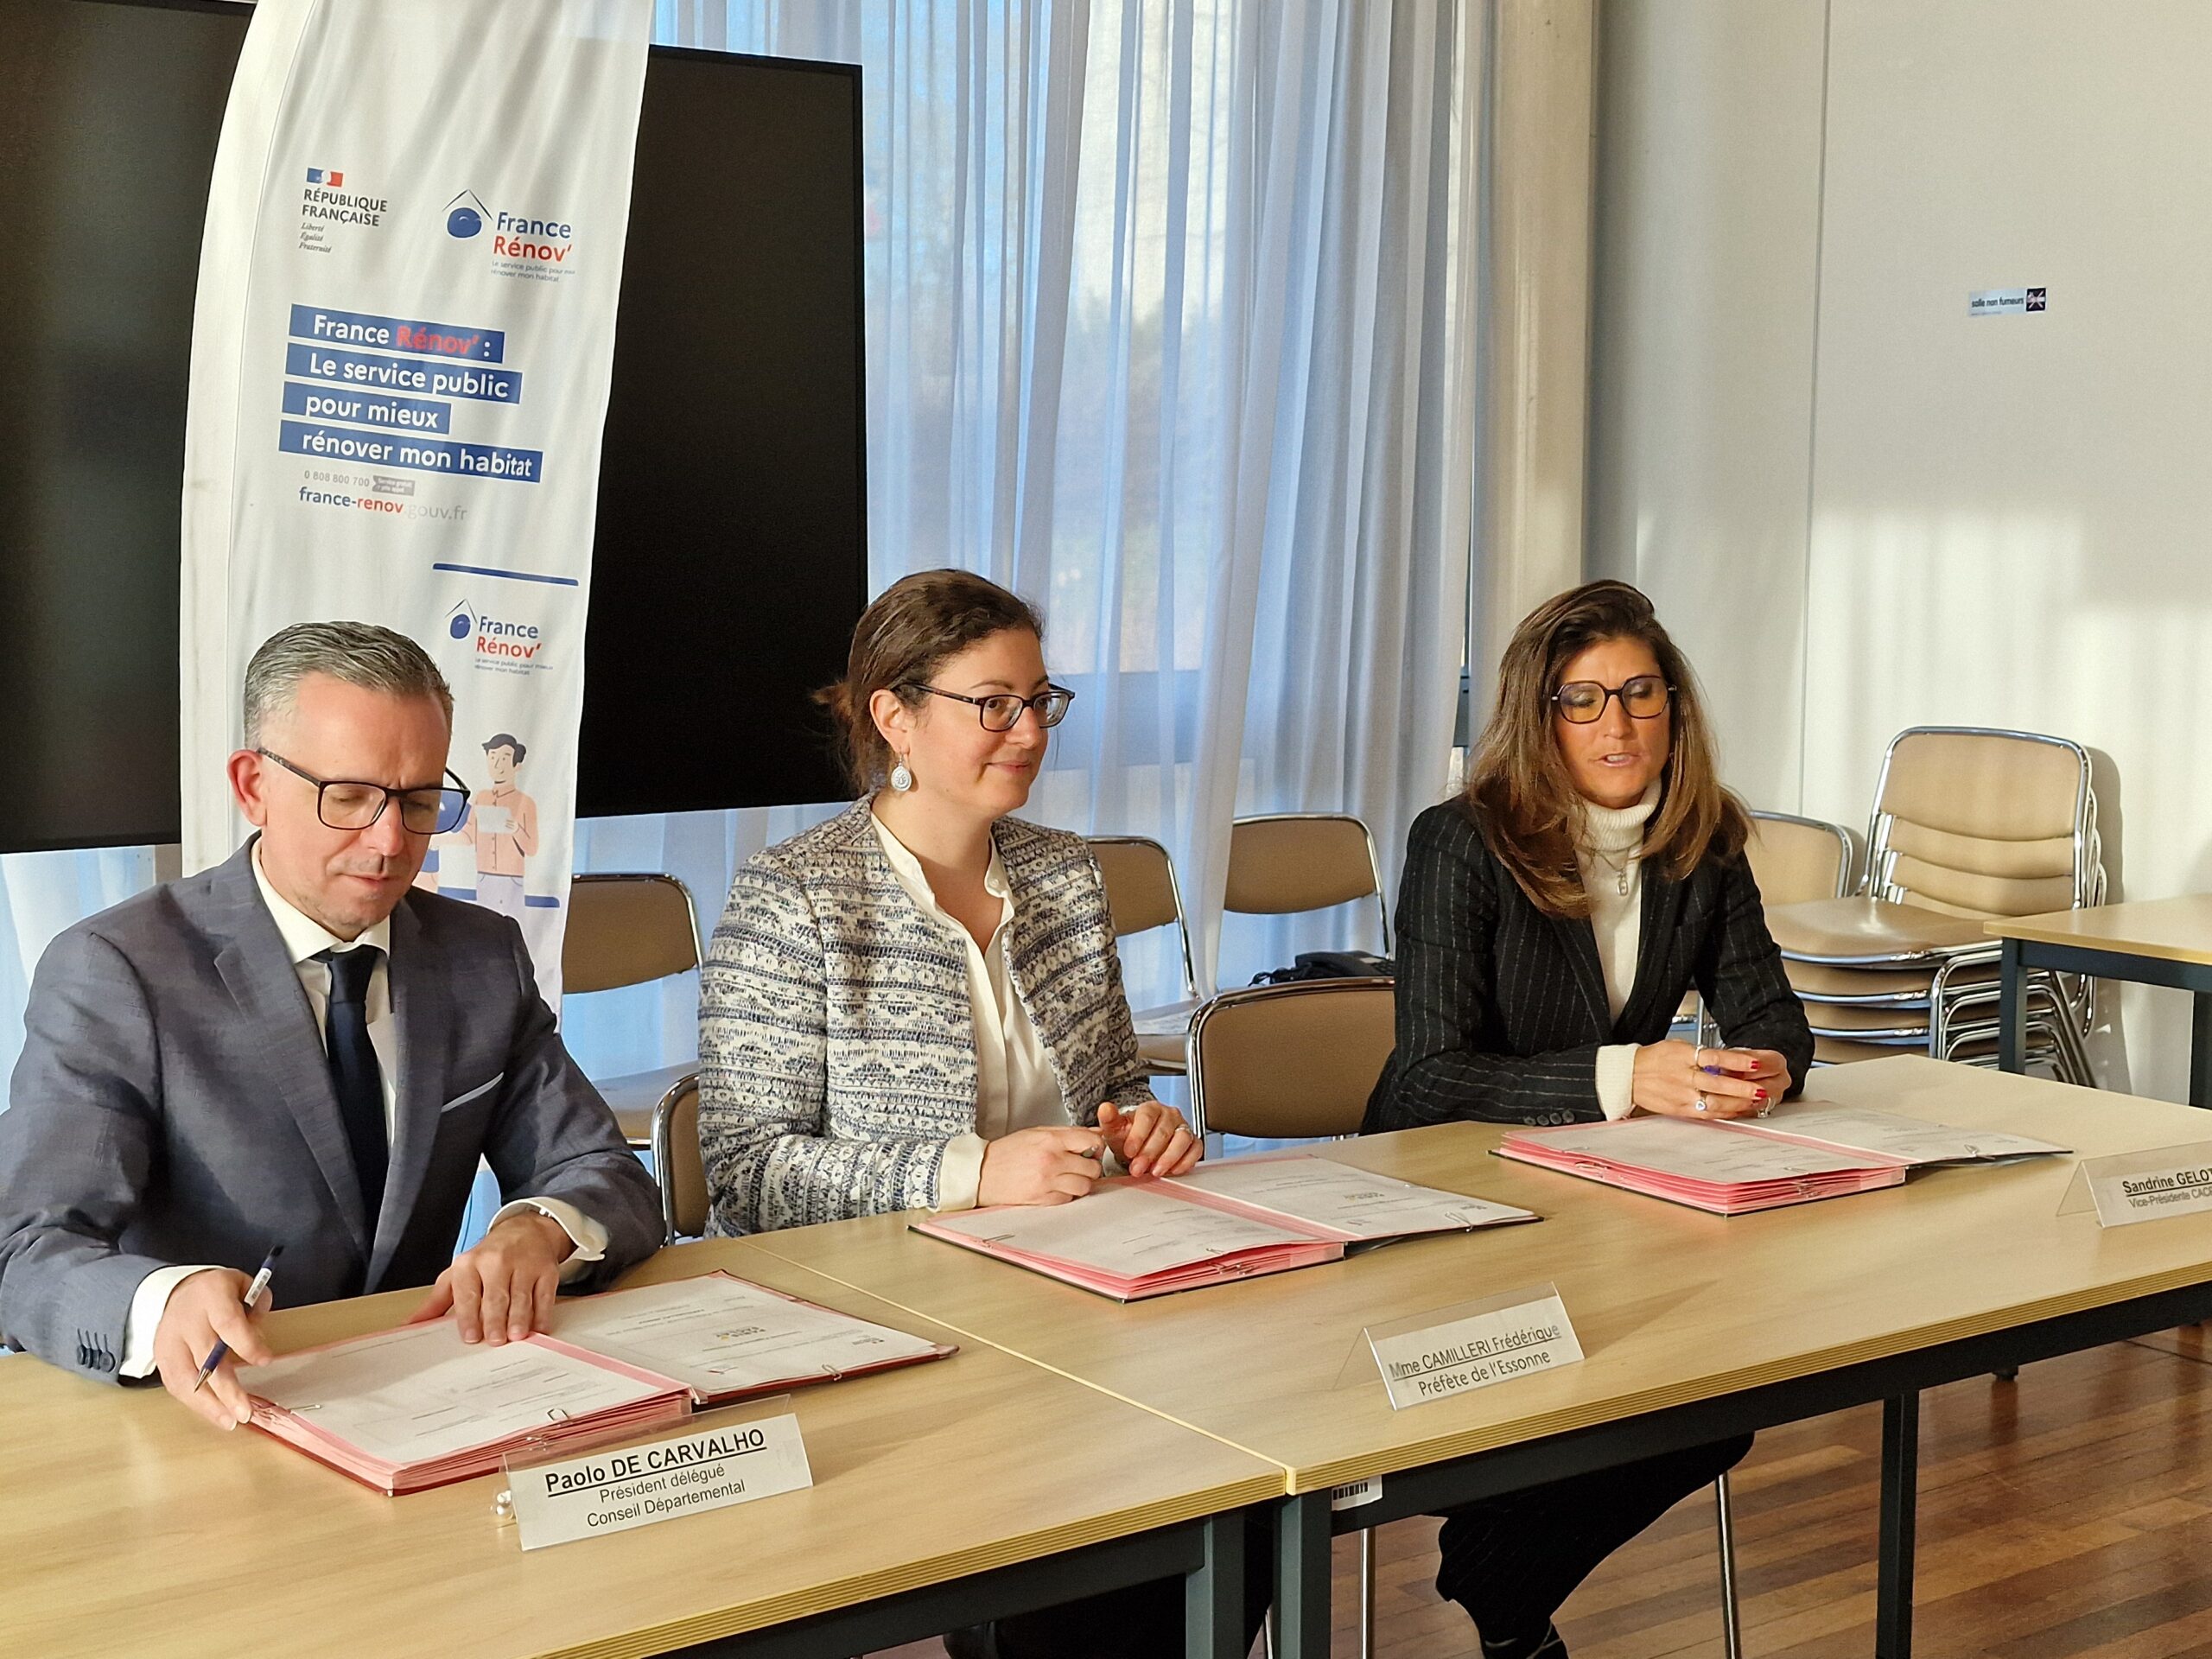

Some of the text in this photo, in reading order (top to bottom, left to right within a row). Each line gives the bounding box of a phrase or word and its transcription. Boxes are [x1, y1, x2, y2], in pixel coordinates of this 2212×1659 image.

[302, 204, 380, 226] FRANÇAISE
[304, 188, 388, 213] RÉPUBLIQUE
[497, 212, 571, 238] France
[493, 235, 572, 262] Rénov'
[314, 314, 390, 345] France
[396, 325, 480, 355] Rénov'
[309, 352, 509, 398] Le service public
[305, 396, 438, 429] pour mieux
[302, 429, 532, 477] rénover mon habitat
[304, 470, 370, 487] 0 808 800 700
[479, 616, 538, 639] France
[476, 636, 542, 658] Rénov'
[2122, 1176, 2175, 1193] Sandrine
[1389, 1323, 1560, 1378] Mme CAMILLERI Frédérique
[1418, 1350, 1551, 1396] Préfète de l'Essonne
[545, 1428, 765, 1493] Paolo DE CARVALHO
[599, 1464, 726, 1503] Président délégué
[587, 1480, 746, 1528] Conseil Départemental
